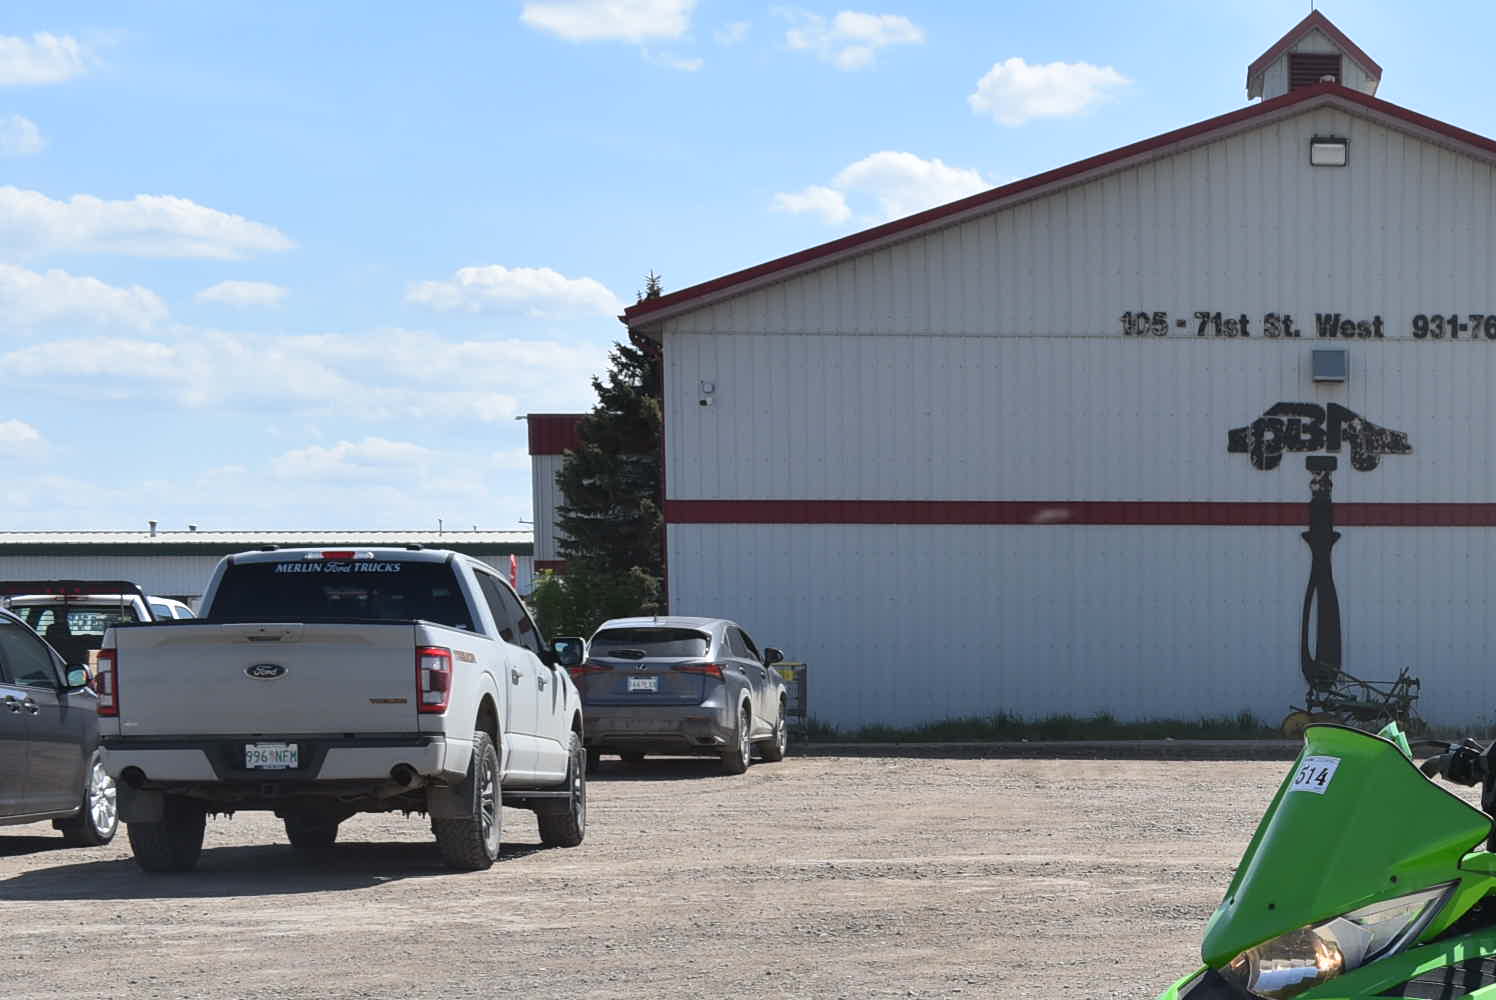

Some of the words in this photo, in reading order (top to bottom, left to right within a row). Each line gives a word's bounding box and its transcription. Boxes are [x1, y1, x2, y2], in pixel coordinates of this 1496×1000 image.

[1121, 311, 1168, 337] 105
[1194, 312, 1249, 337] 71st
[1264, 312, 1301, 338] St.
[1315, 313, 1384, 338] West
[274, 562, 321, 572] MERLIN
[354, 562, 401, 572] TRUCKS
[1295, 765, 1328, 786] 514
